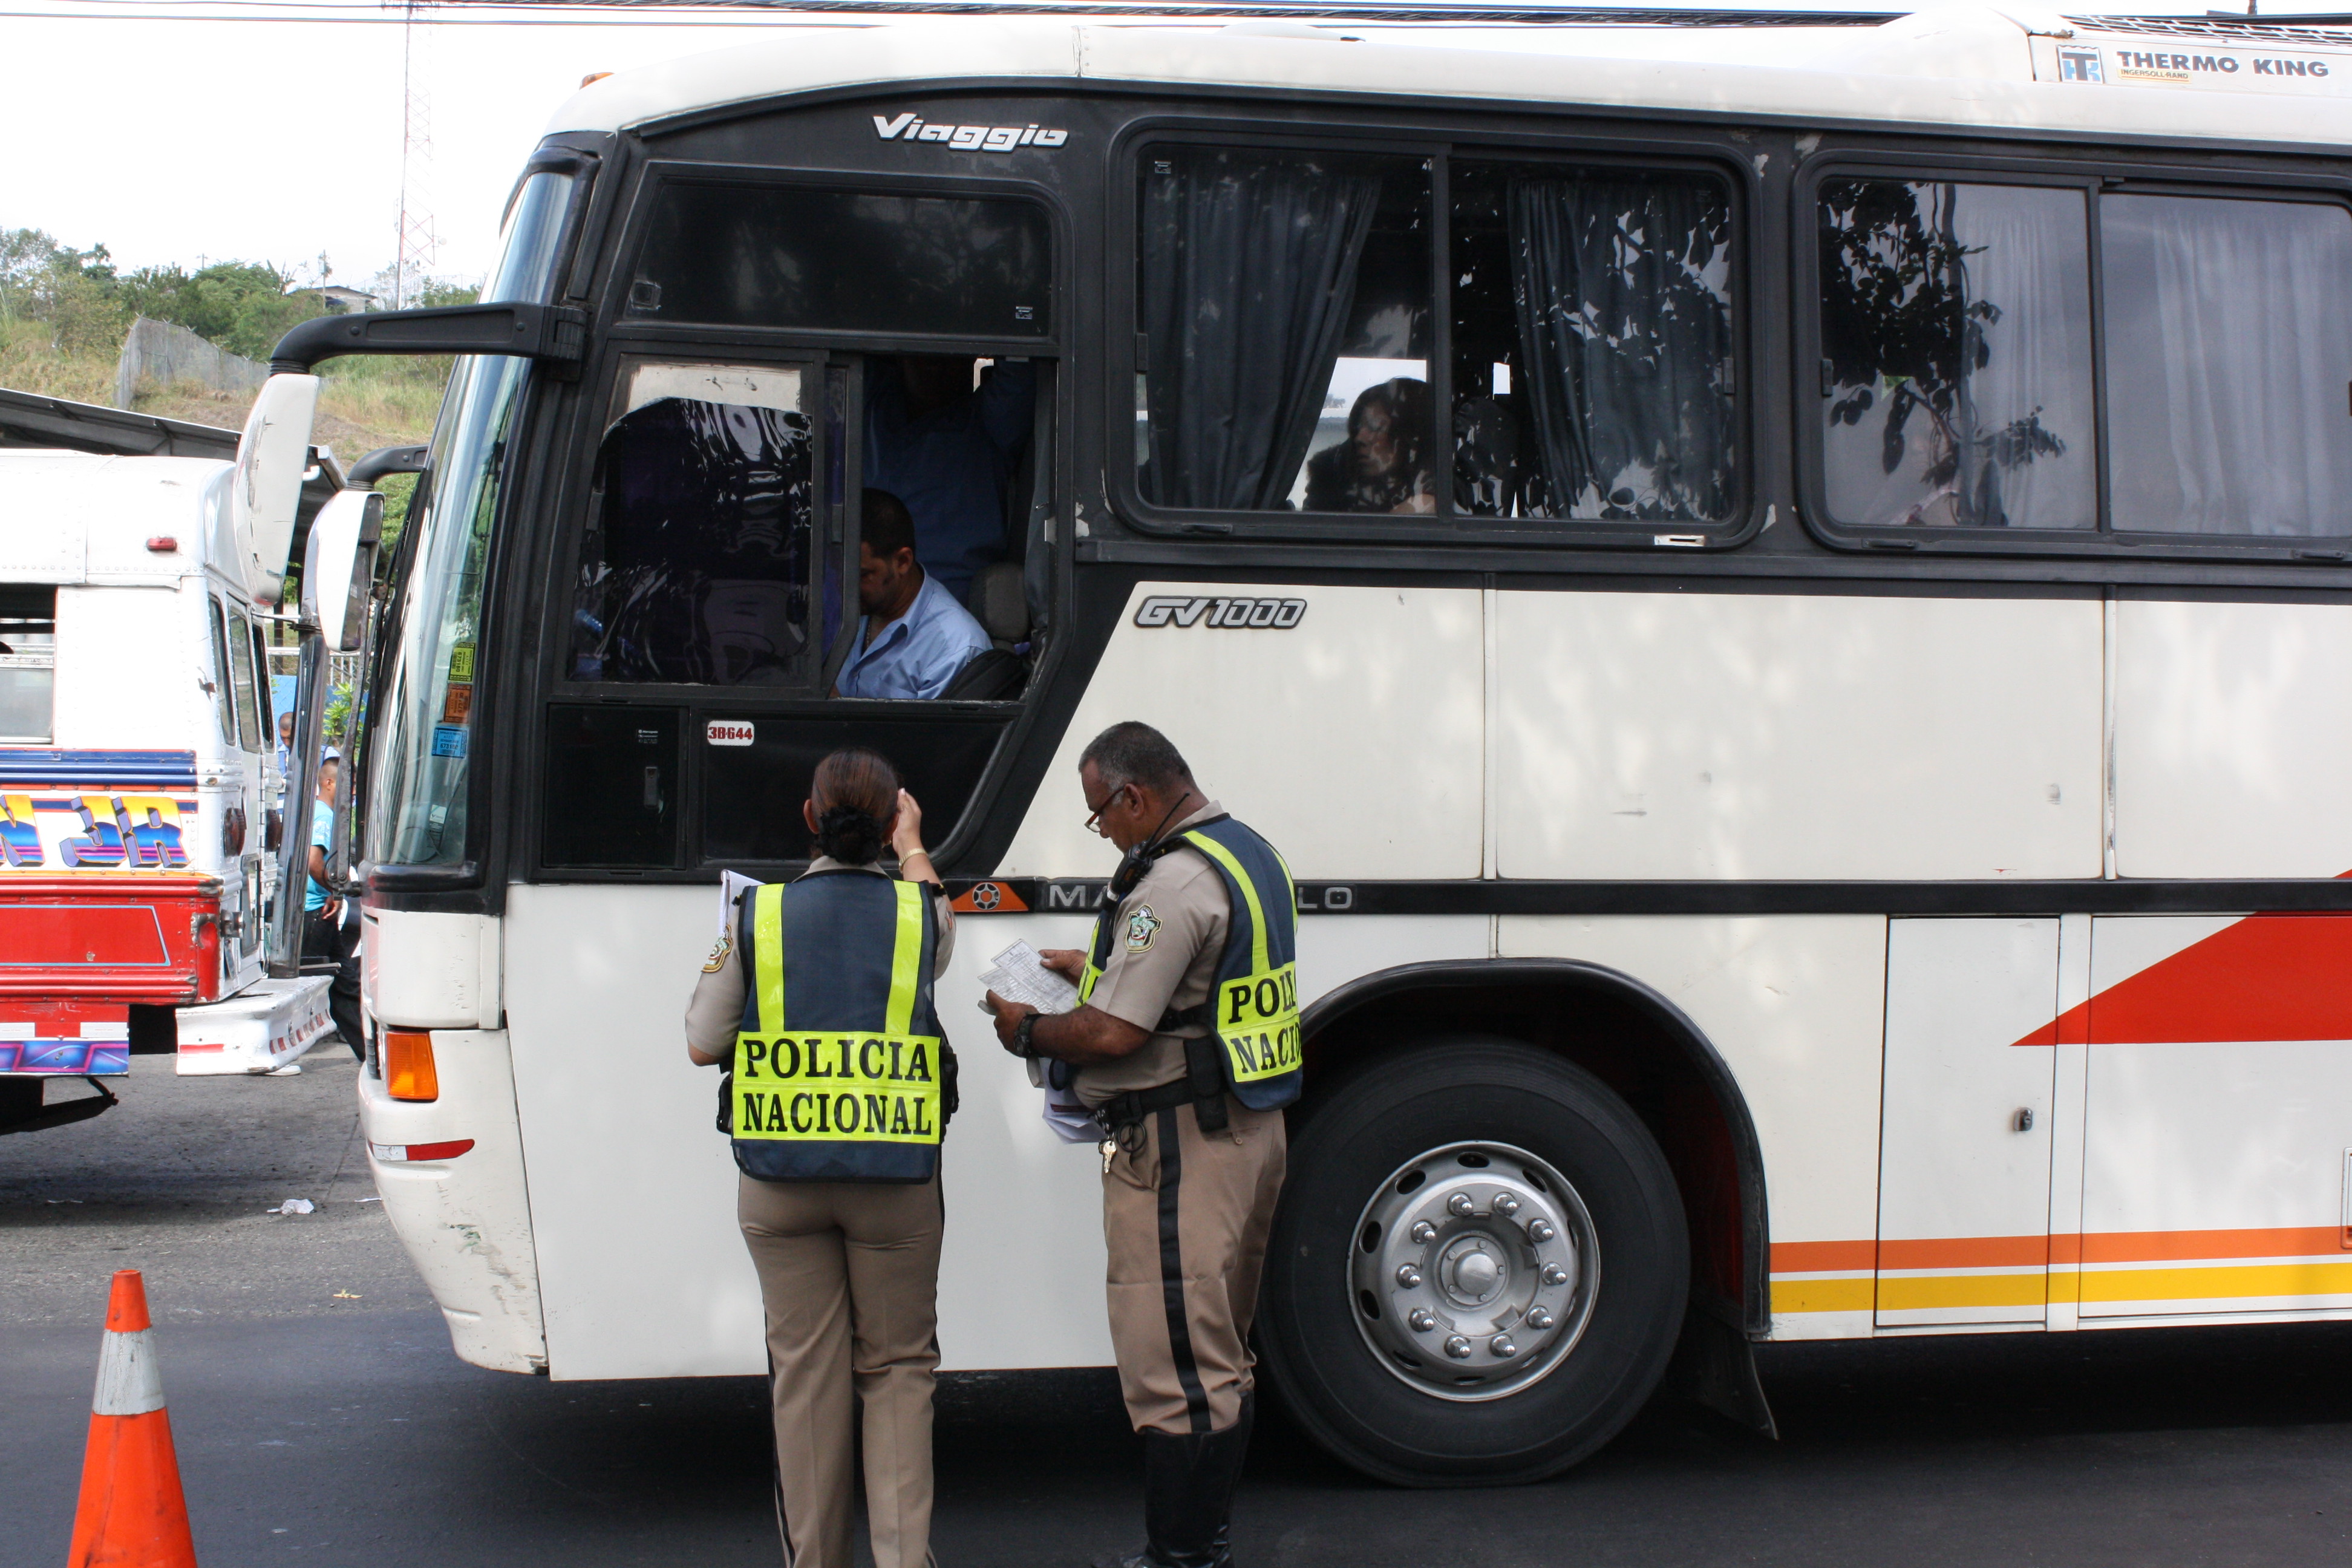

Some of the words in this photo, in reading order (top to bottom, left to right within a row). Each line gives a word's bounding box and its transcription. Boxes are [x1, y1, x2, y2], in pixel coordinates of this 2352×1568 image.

[2117, 51, 2238, 73] THERMO
[2252, 59, 2329, 77] KING
[872, 112, 1069, 152] Viaggio
[59, 795, 192, 868] JR
[1228, 968, 1297, 1024] POLI
[743, 1037, 932, 1082] POLICIA
[743, 1093, 932, 1135] NACIONAL
